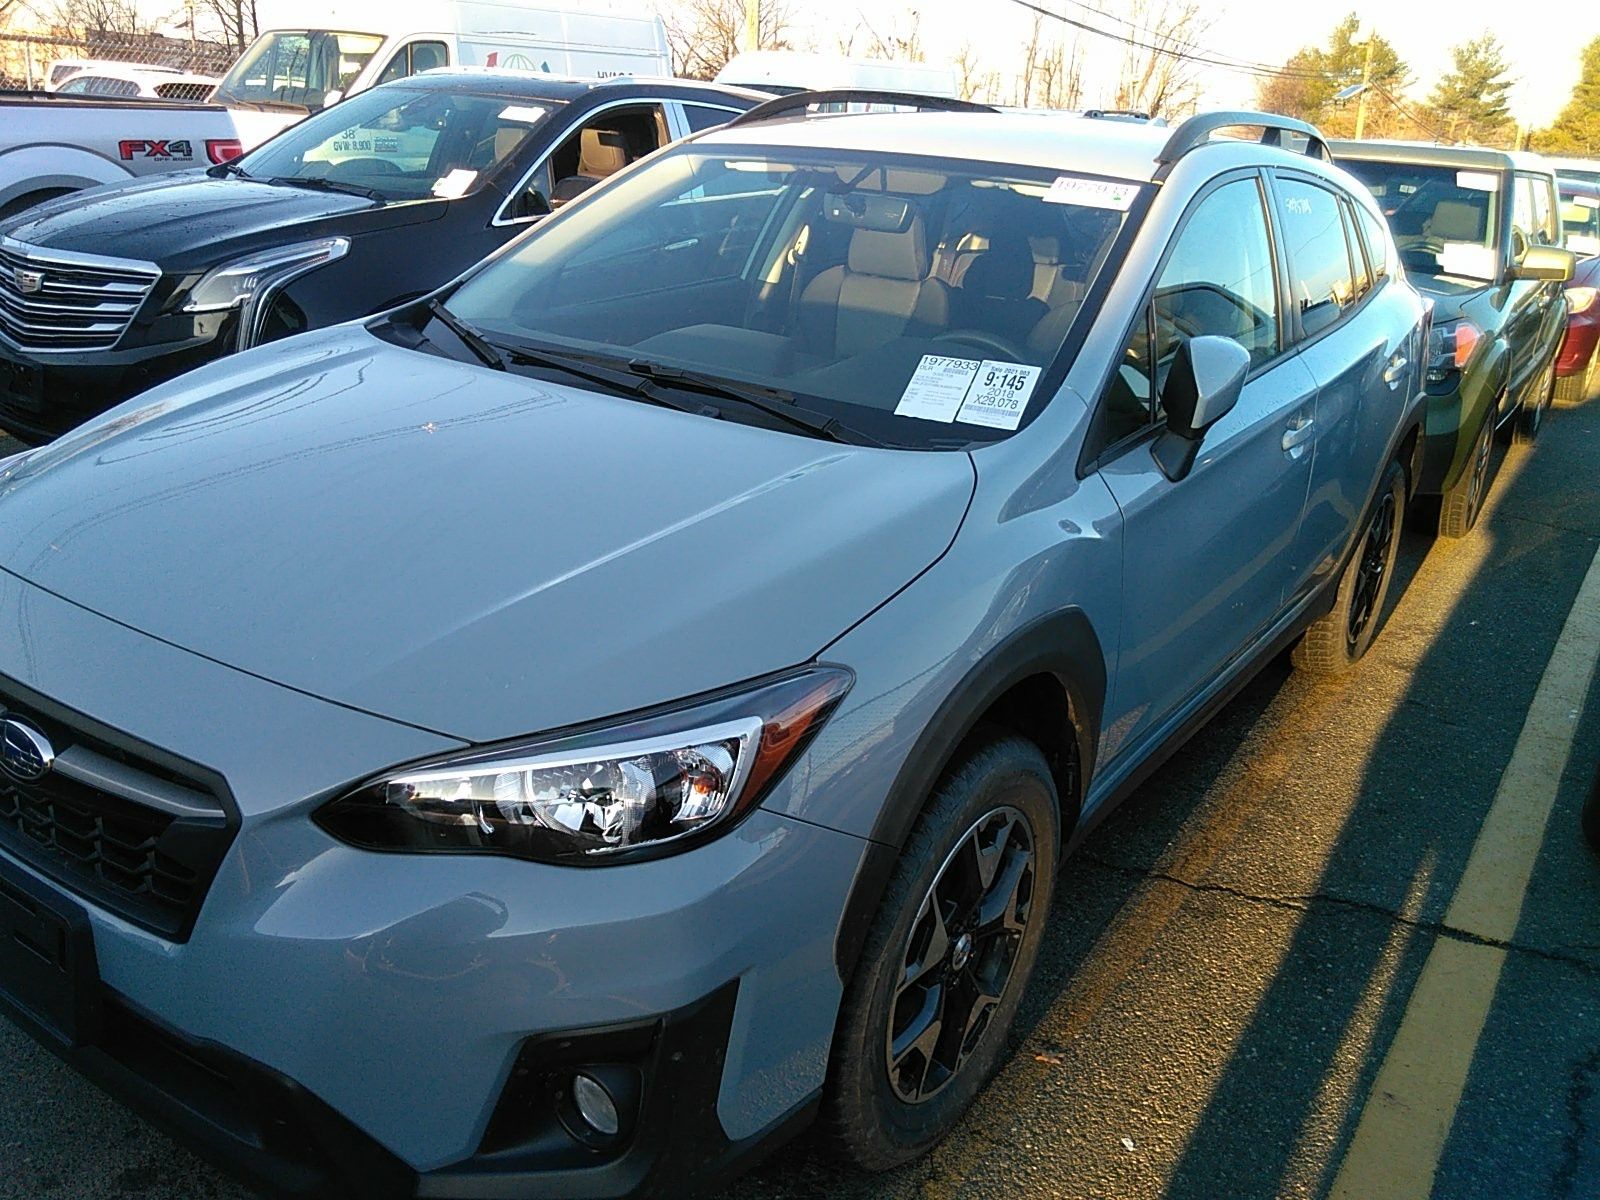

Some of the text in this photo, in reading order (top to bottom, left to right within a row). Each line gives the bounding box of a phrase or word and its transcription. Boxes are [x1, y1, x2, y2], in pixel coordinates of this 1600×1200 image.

[118, 140, 192, 160] FX4
[923, 356, 979, 371] 1977933
[984, 371, 1027, 391] 9:145
[986, 387, 1015, 399] 2018
